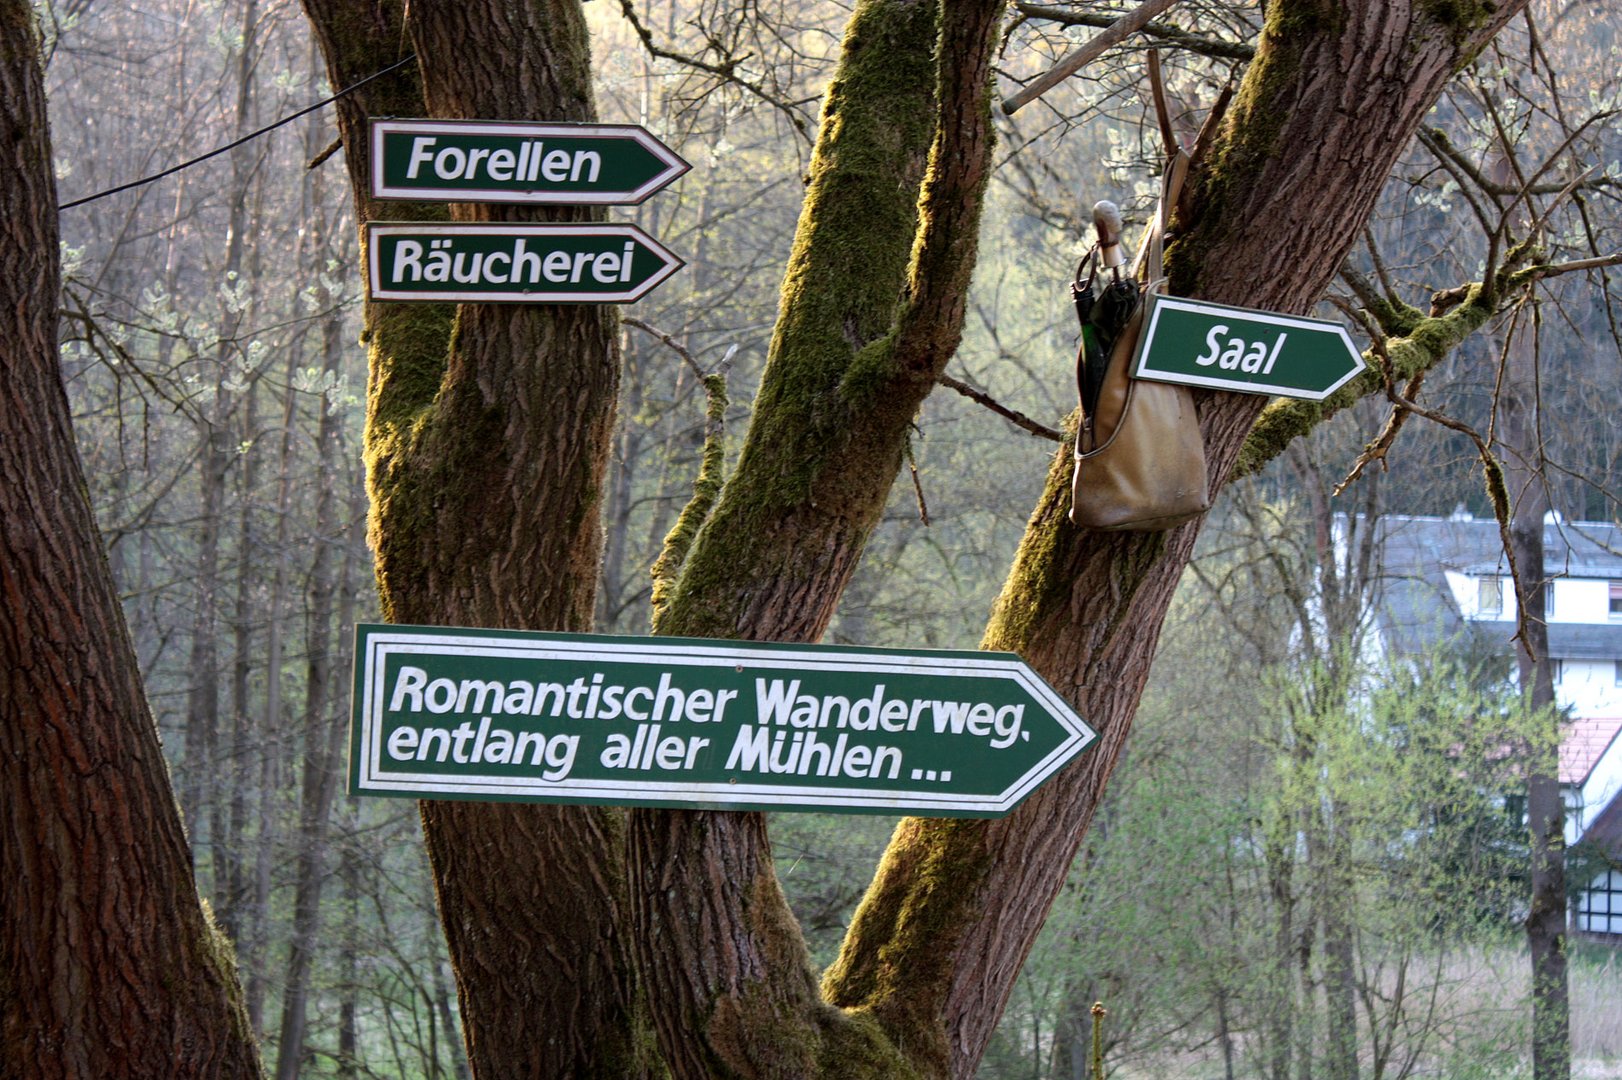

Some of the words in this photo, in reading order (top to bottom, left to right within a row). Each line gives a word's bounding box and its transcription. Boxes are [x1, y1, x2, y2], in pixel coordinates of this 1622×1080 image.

[405, 137, 602, 183] Forellen
[391, 239, 635, 284] Räucherei
[1195, 324, 1288, 375] Saal
[388, 666, 739, 723] Romantischer
[387, 717, 581, 782] entlang
[600, 723, 711, 771] aller
[725, 724, 903, 779] Mühlen
